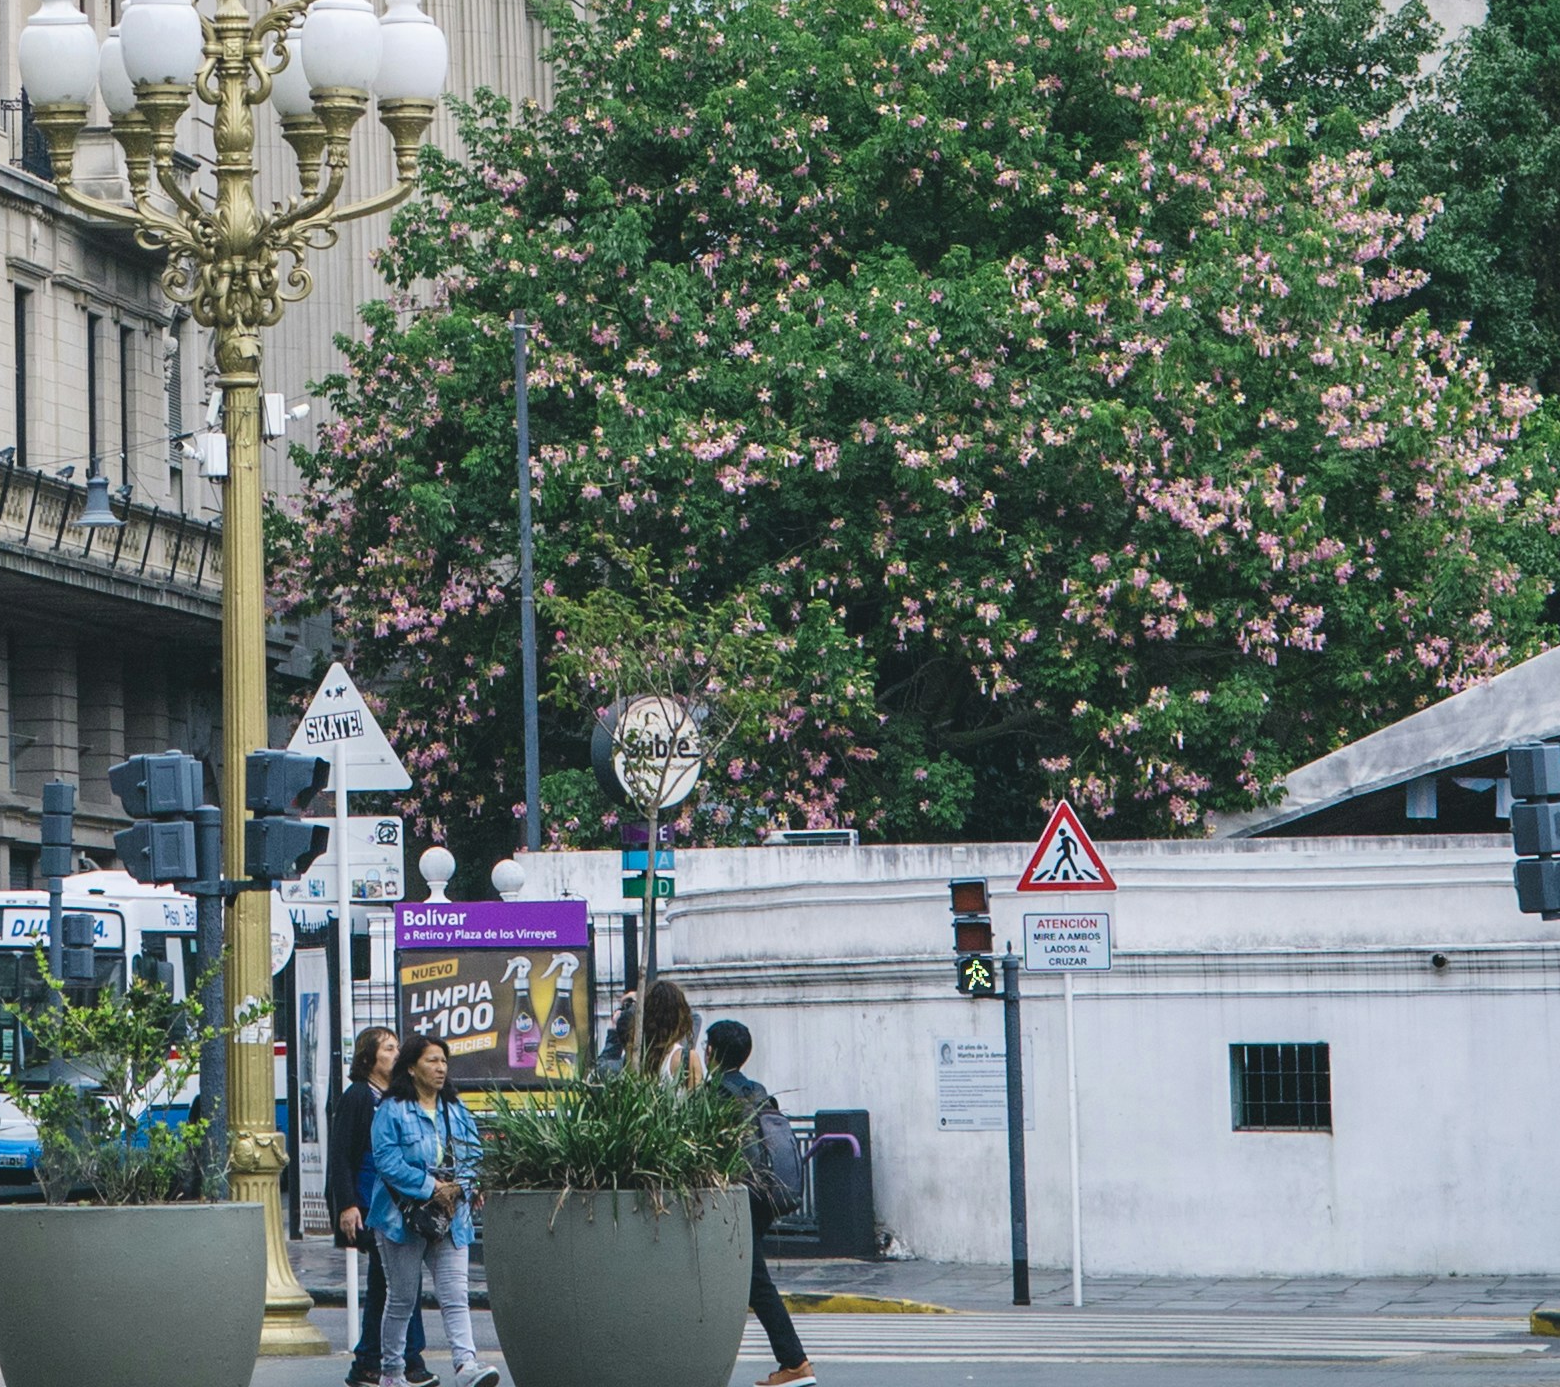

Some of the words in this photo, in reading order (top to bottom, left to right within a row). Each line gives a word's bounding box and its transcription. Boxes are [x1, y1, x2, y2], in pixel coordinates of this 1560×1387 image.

[306, 712, 364, 743] SKATE!
[658, 853, 670, 866] A
[658, 879, 670, 895] D
[402, 909, 467, 927] Bolívar
[1037, 917, 1098, 929] ATENCIÓN
[404, 933, 411, 941] a
[413, 931, 444, 941] Retiro
[446, 932, 453, 942] y
[455, 929, 481, 940] Plaza
[484, 929, 497, 940] de
[500, 929, 514, 940] los
[516, 928, 557, 941] Virreyes
[1033, 933, 1056, 941] MIRE
[1058, 933, 1065, 941] A
[1067, 933, 1101, 941] AMBOS
[1044, 946, 1076, 954] LADOS
[1048, 958, 1087, 966] CRUZAR
[411, 964, 453, 980] NUEVO
[410, 980, 493, 1014] LIMPIA
[414, 1002, 494, 1038] +100
[516, 1034, 524, 1063] MULTI
[546, 1039, 556, 1072] MULTI
